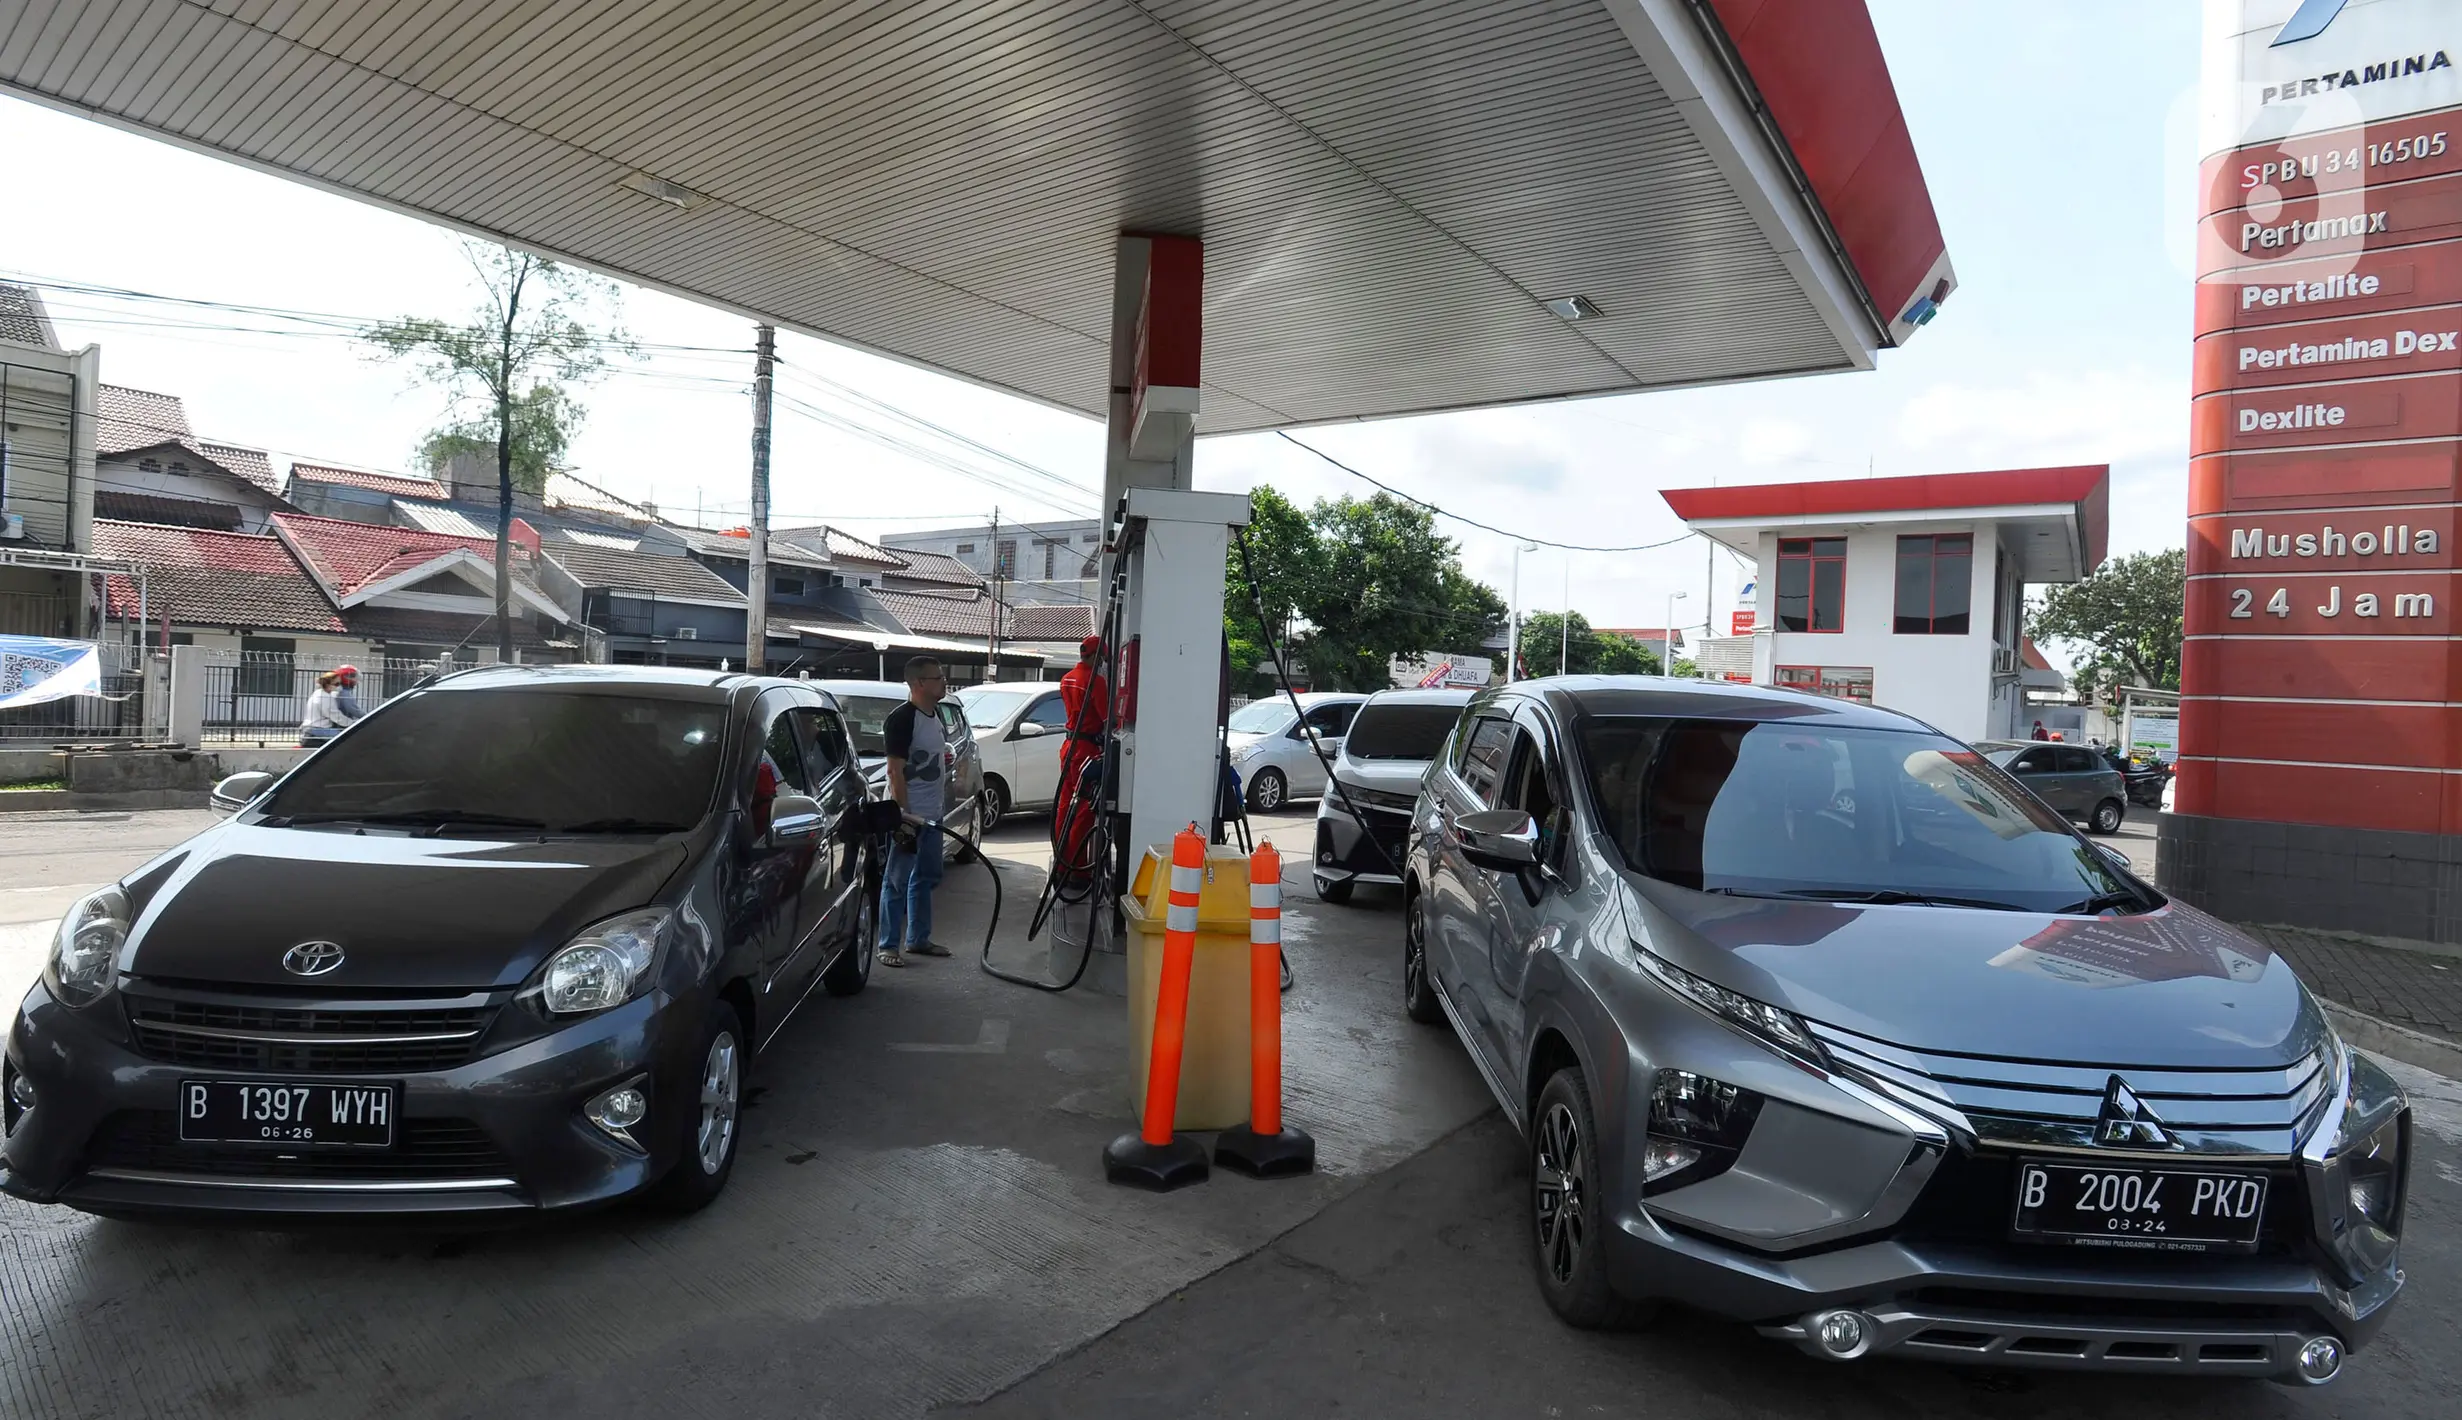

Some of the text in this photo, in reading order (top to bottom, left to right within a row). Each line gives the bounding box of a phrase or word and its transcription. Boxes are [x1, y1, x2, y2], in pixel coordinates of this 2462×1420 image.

[2260, 50, 2452, 105] PERTAMINA
[2240, 131, 2448, 189] SPBU 34 16505
[2242, 210, 2388, 252] Pertamax
[2242, 273, 2380, 309] Pertalite
[2239, 330, 2459, 370] Pertamina Dex
[2239, 403, 2345, 432] Dexlite
[2230, 525, 2440, 560] Musholla
[2229, 586, 2434, 619] 24 Jam
[190, 1086, 388, 1126] B 1397 WYH
[2023, 1169, 2260, 1218] B 2004 PKD
[2074, 1238, 2112, 1246] MITSUBISHI
